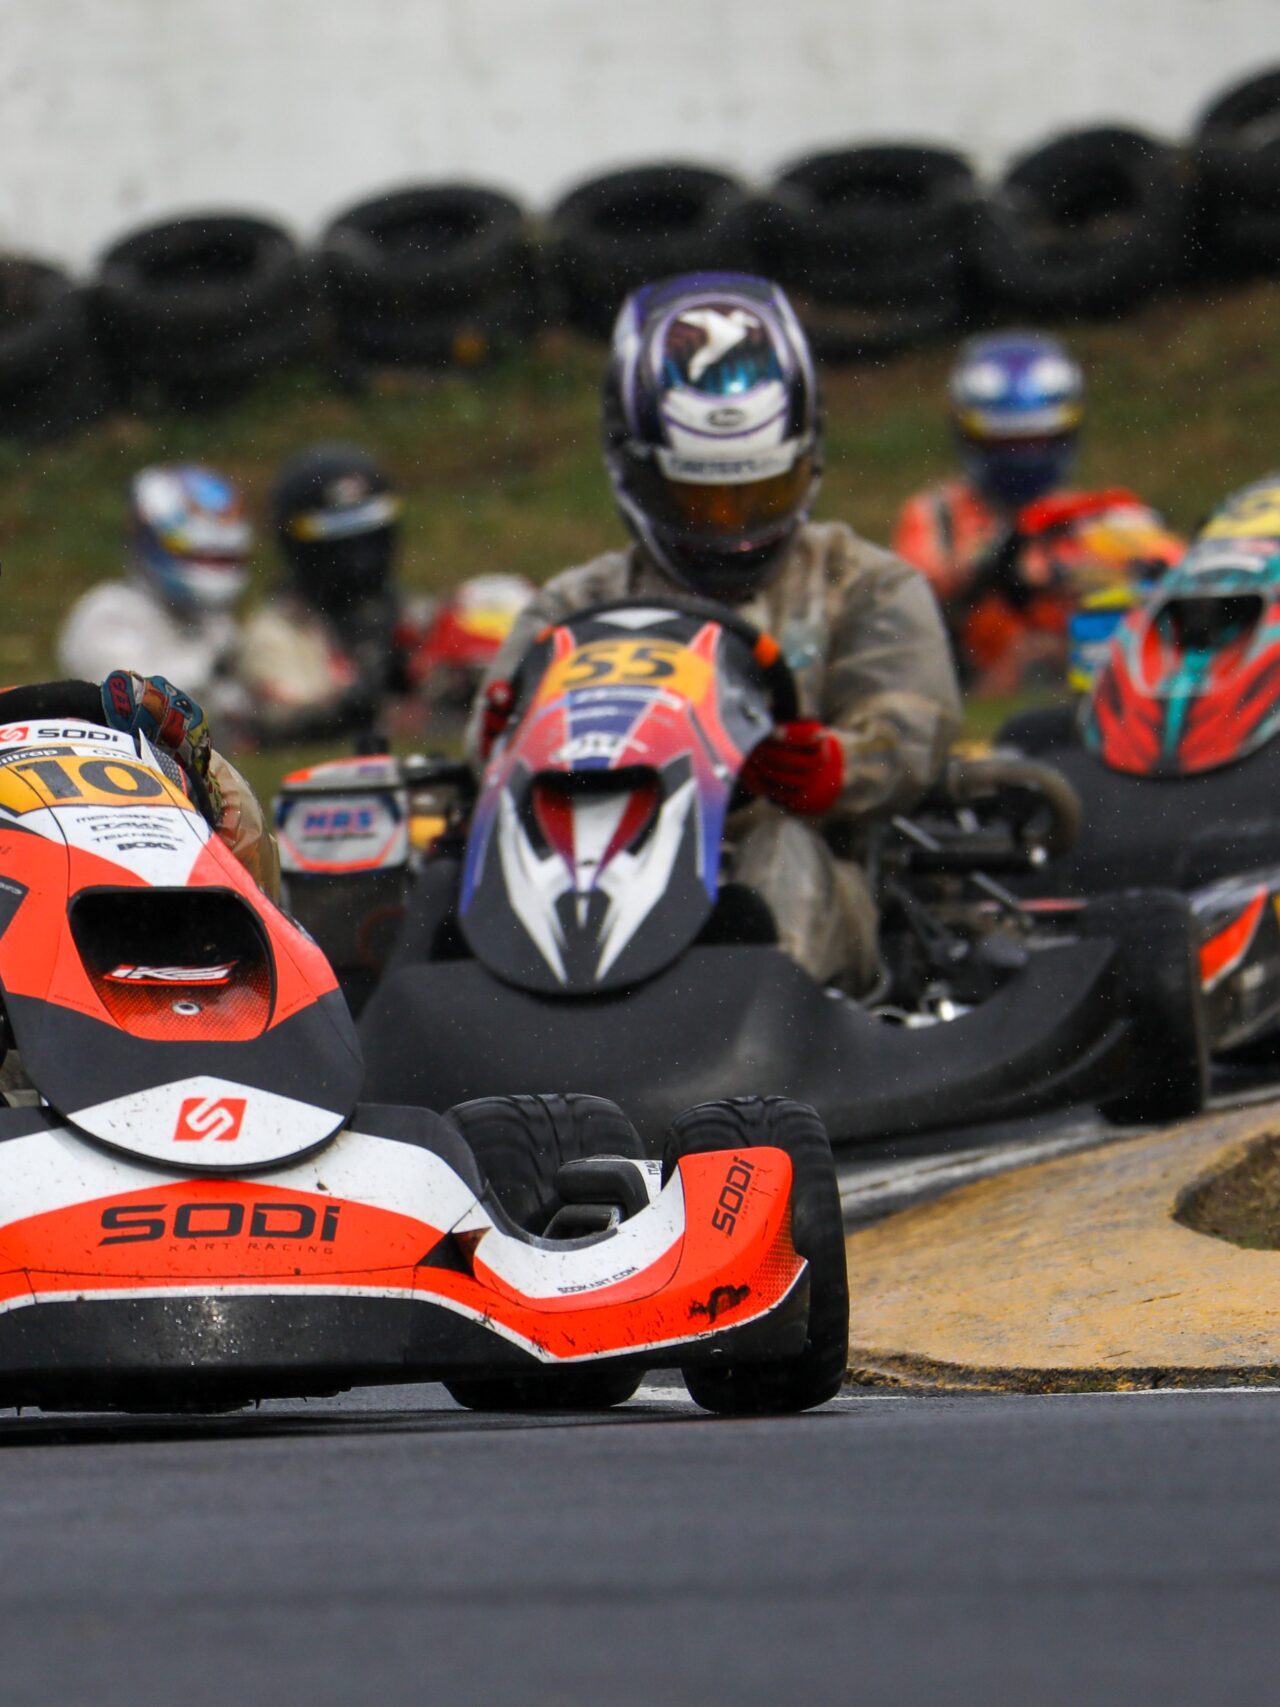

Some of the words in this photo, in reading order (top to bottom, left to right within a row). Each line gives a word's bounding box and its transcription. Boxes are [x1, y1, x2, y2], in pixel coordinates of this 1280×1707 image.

[564, 647, 675, 687] 55
[16, 760, 163, 800] 10
[169, 1242, 232, 1252] KART
[247, 1242, 335, 1256] RACING
